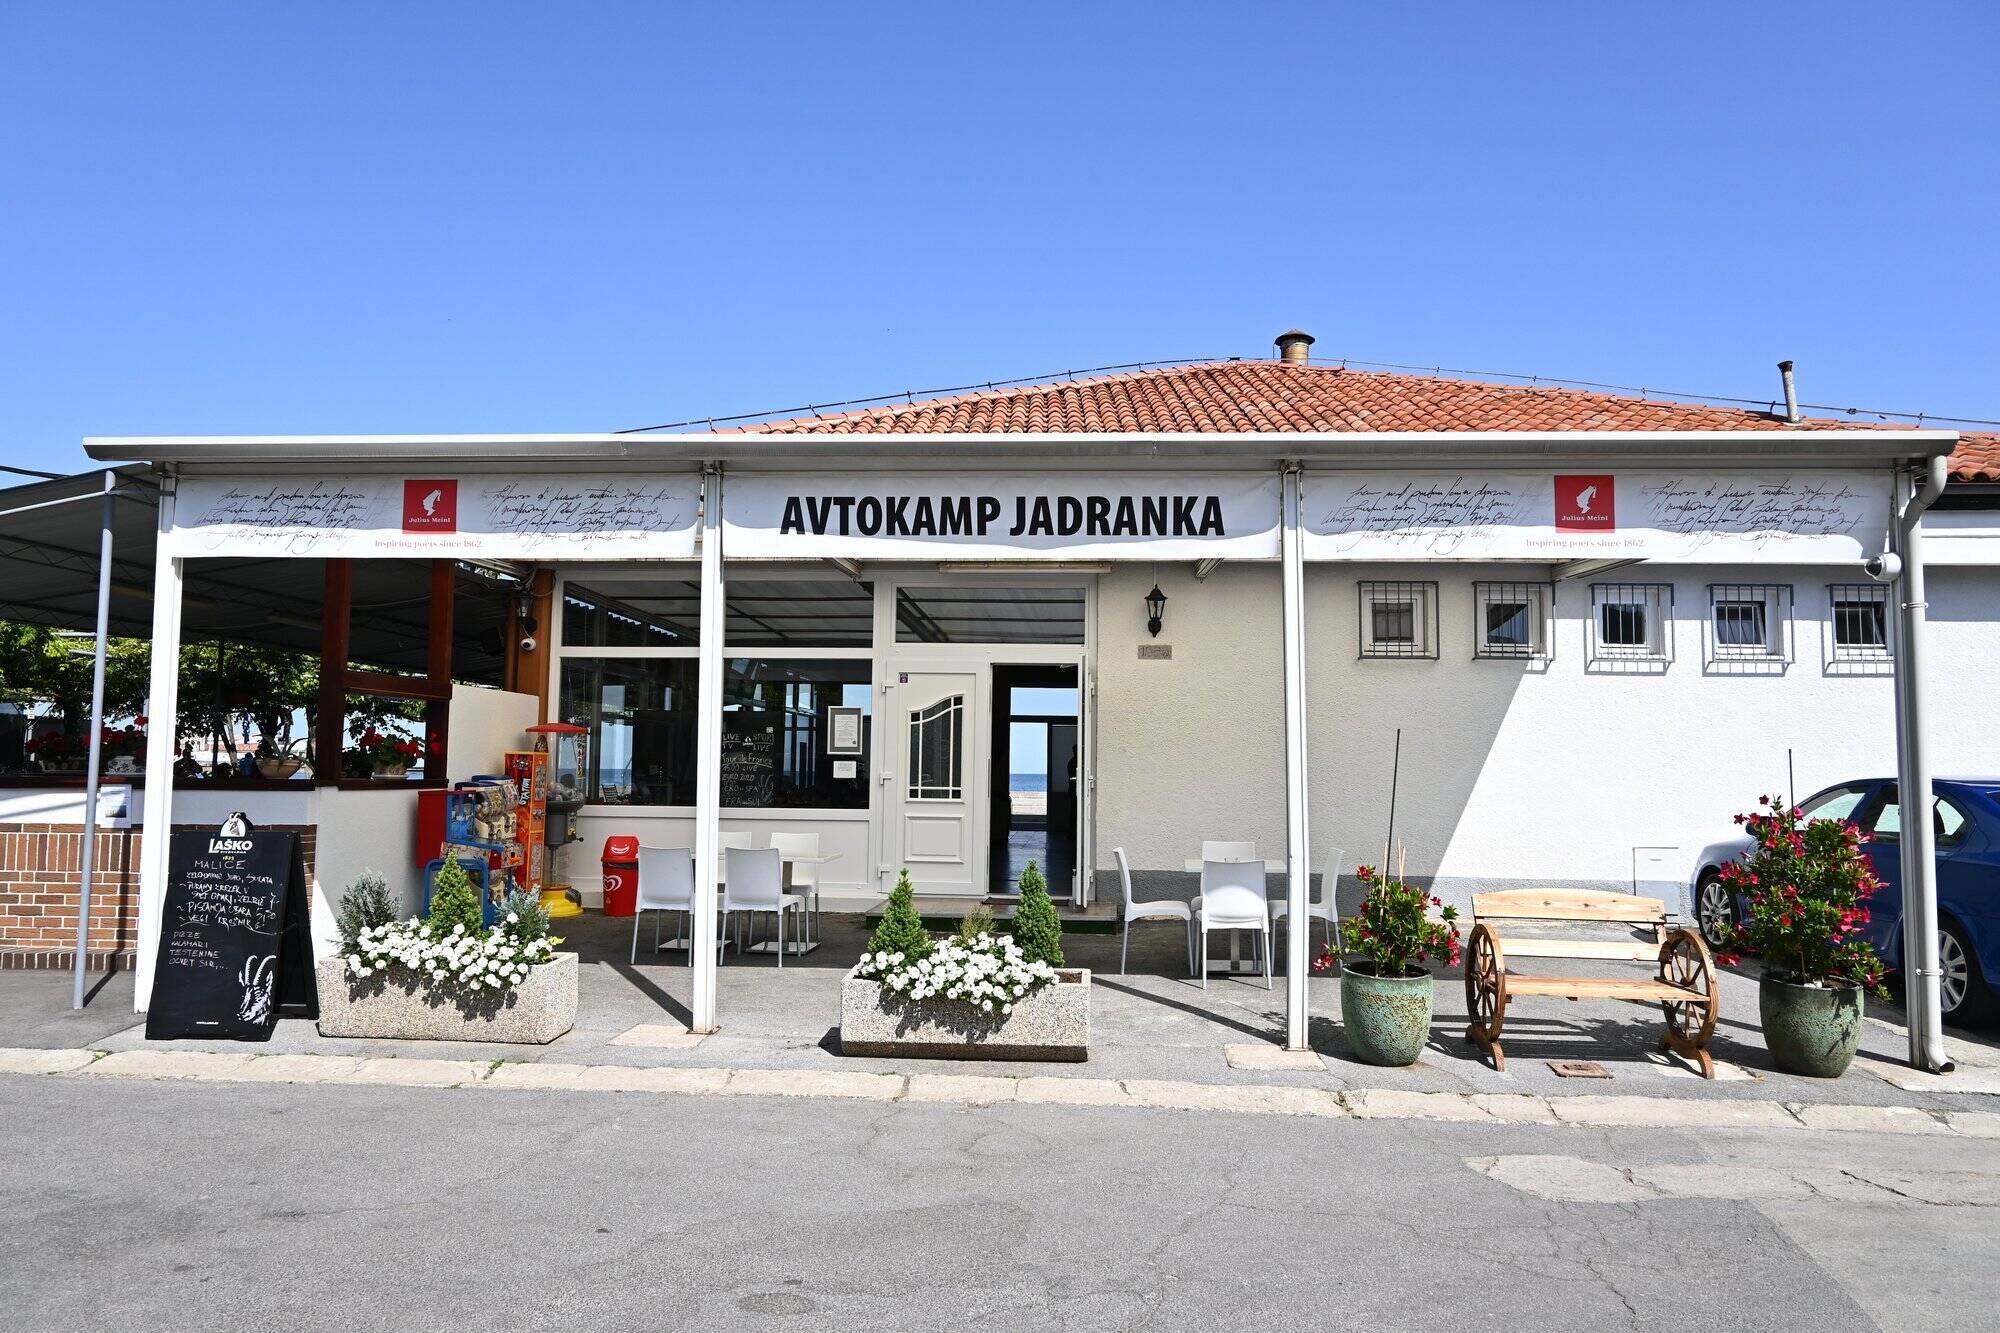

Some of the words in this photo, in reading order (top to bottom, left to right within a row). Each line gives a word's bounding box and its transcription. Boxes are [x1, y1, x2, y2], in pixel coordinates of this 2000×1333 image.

[780, 496, 1001, 536] AVTOKAMP
[1009, 496, 1225, 536] JADRANKA
[375, 540, 413, 549] Inspiring
[415, 541, 437, 549] poets
[1526, 539, 1568, 548] Inspiring
[1570, 540, 1595, 548] poets
[1598, 539, 1621, 547] since
[194, 860, 246, 870] MALICE
[169, 949, 220, 959] TESTENINE
